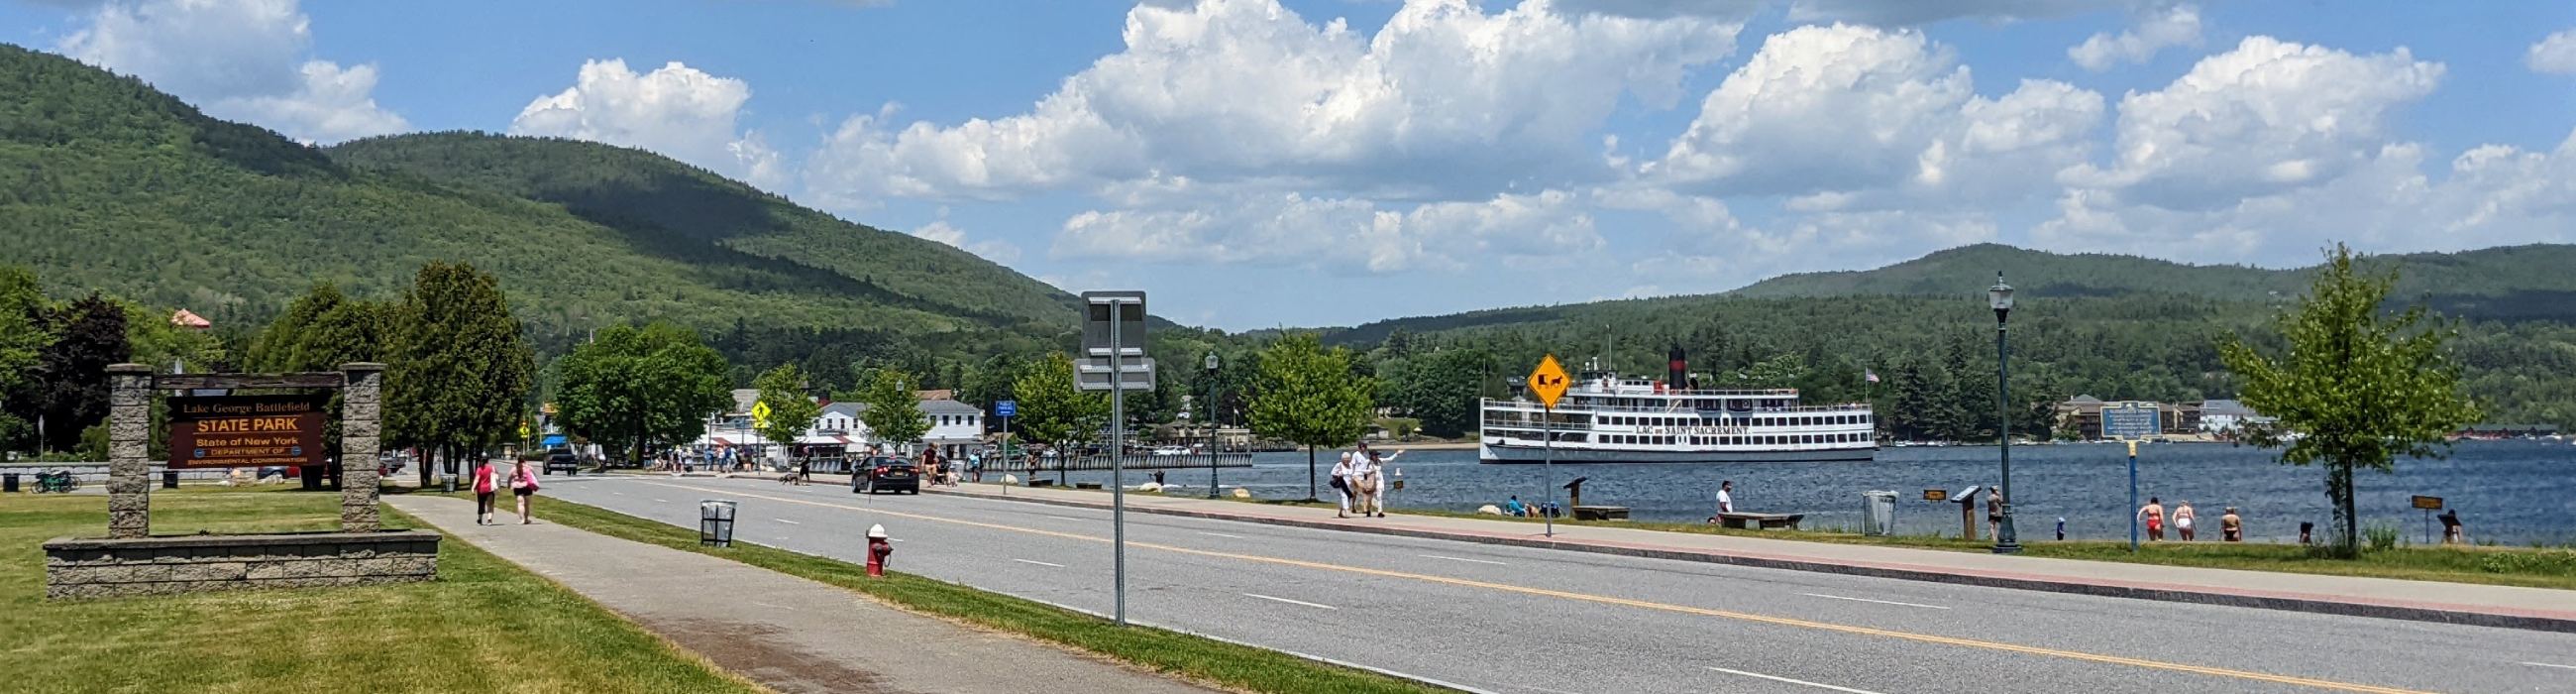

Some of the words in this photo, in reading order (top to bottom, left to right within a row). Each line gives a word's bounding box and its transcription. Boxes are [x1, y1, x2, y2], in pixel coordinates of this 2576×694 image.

[183, 404, 209, 413] Lake
[213, 404, 252, 414] George
[256, 402, 310, 412] Battlefield
[198, 419, 250, 432] STATE
[254, 418, 298, 430] PARK
[196, 438, 227, 447] State
